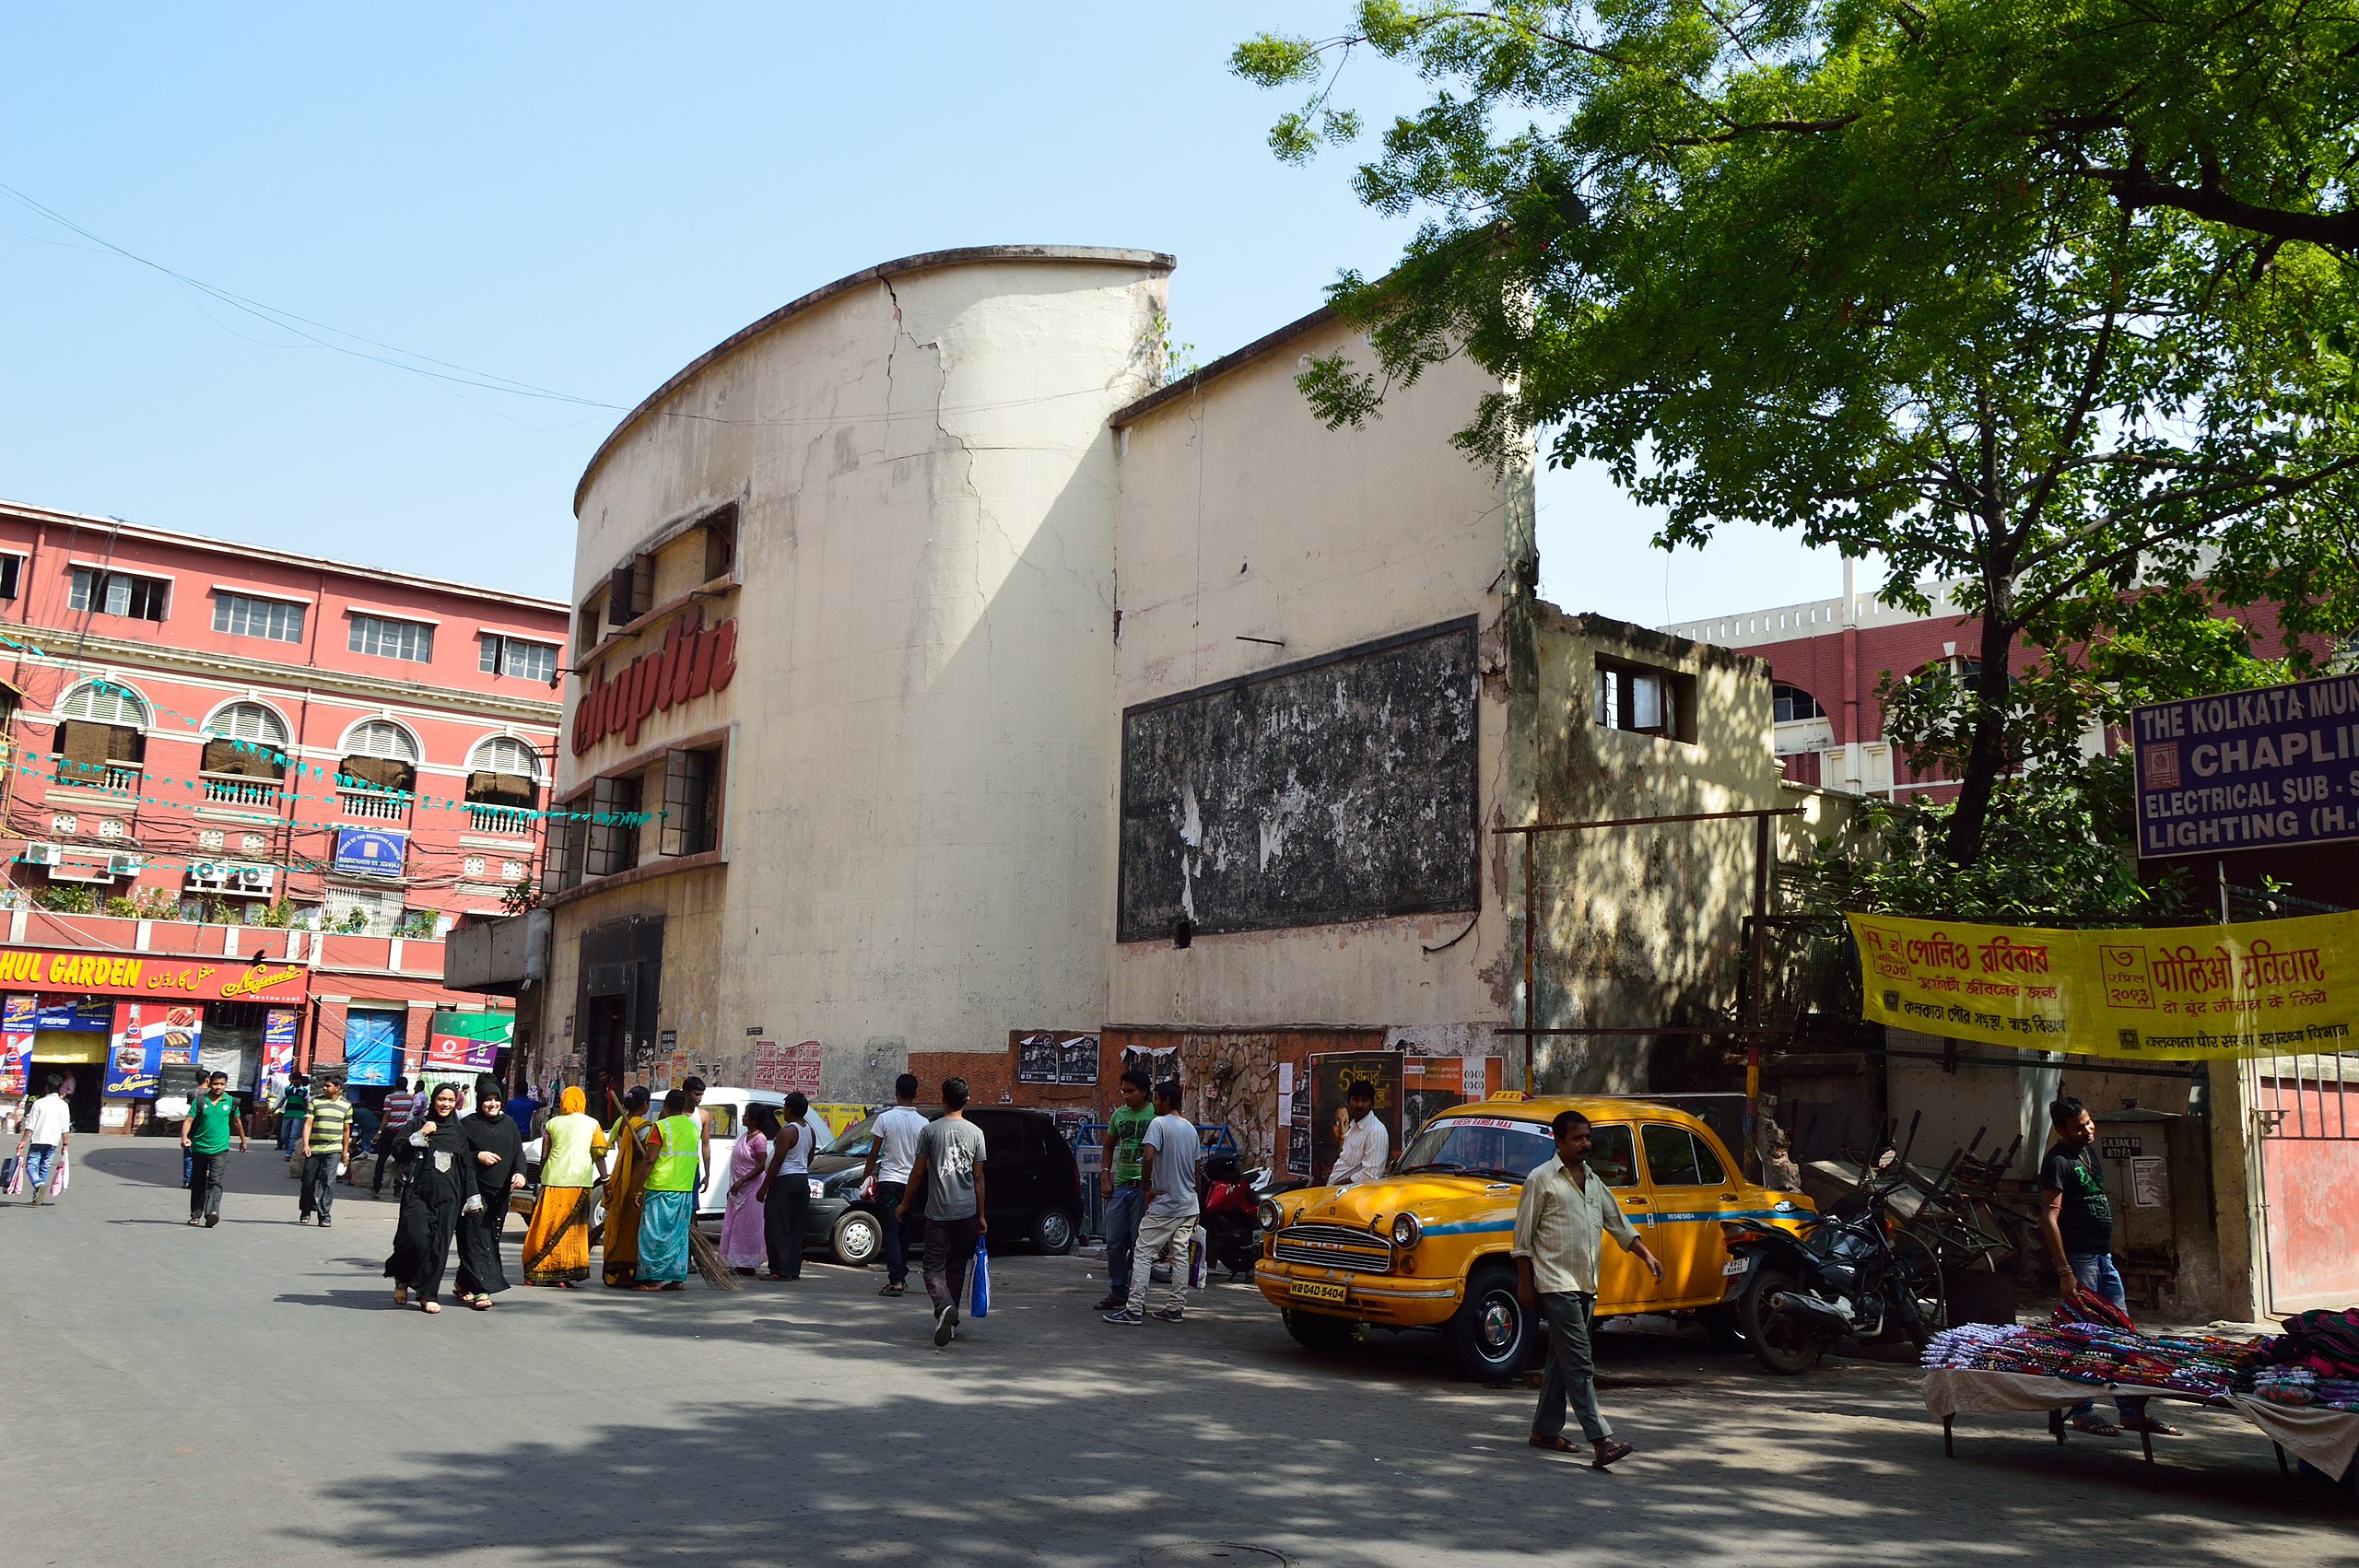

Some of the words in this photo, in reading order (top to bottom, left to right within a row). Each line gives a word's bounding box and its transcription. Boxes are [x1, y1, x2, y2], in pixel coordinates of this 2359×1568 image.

[572, 606, 737, 757] chaplin
[2141, 706, 2185, 741] THE
[2190, 688, 2304, 734] KOLKATA
[2145, 781, 2276, 819] ELECTRICAL
[2282, 775, 2329, 804] SUB
[2149, 811, 2299, 849] LIGHTING
[2310, 805, 2359, 837] (H.
[49, 954, 143, 987] GARDEN
[1907, 931, 1971, 970] পোলিও
[1978, 936, 2049, 974] রবিবার
[2240, 939, 2326, 989] रविवार
[40, 1017, 70, 1025] PEPSI
[1904, 1000, 1944, 1020] কলকাতা
[2163, 1000, 2178, 1013] दो
[1496, 1118, 1514, 1129] MAA
